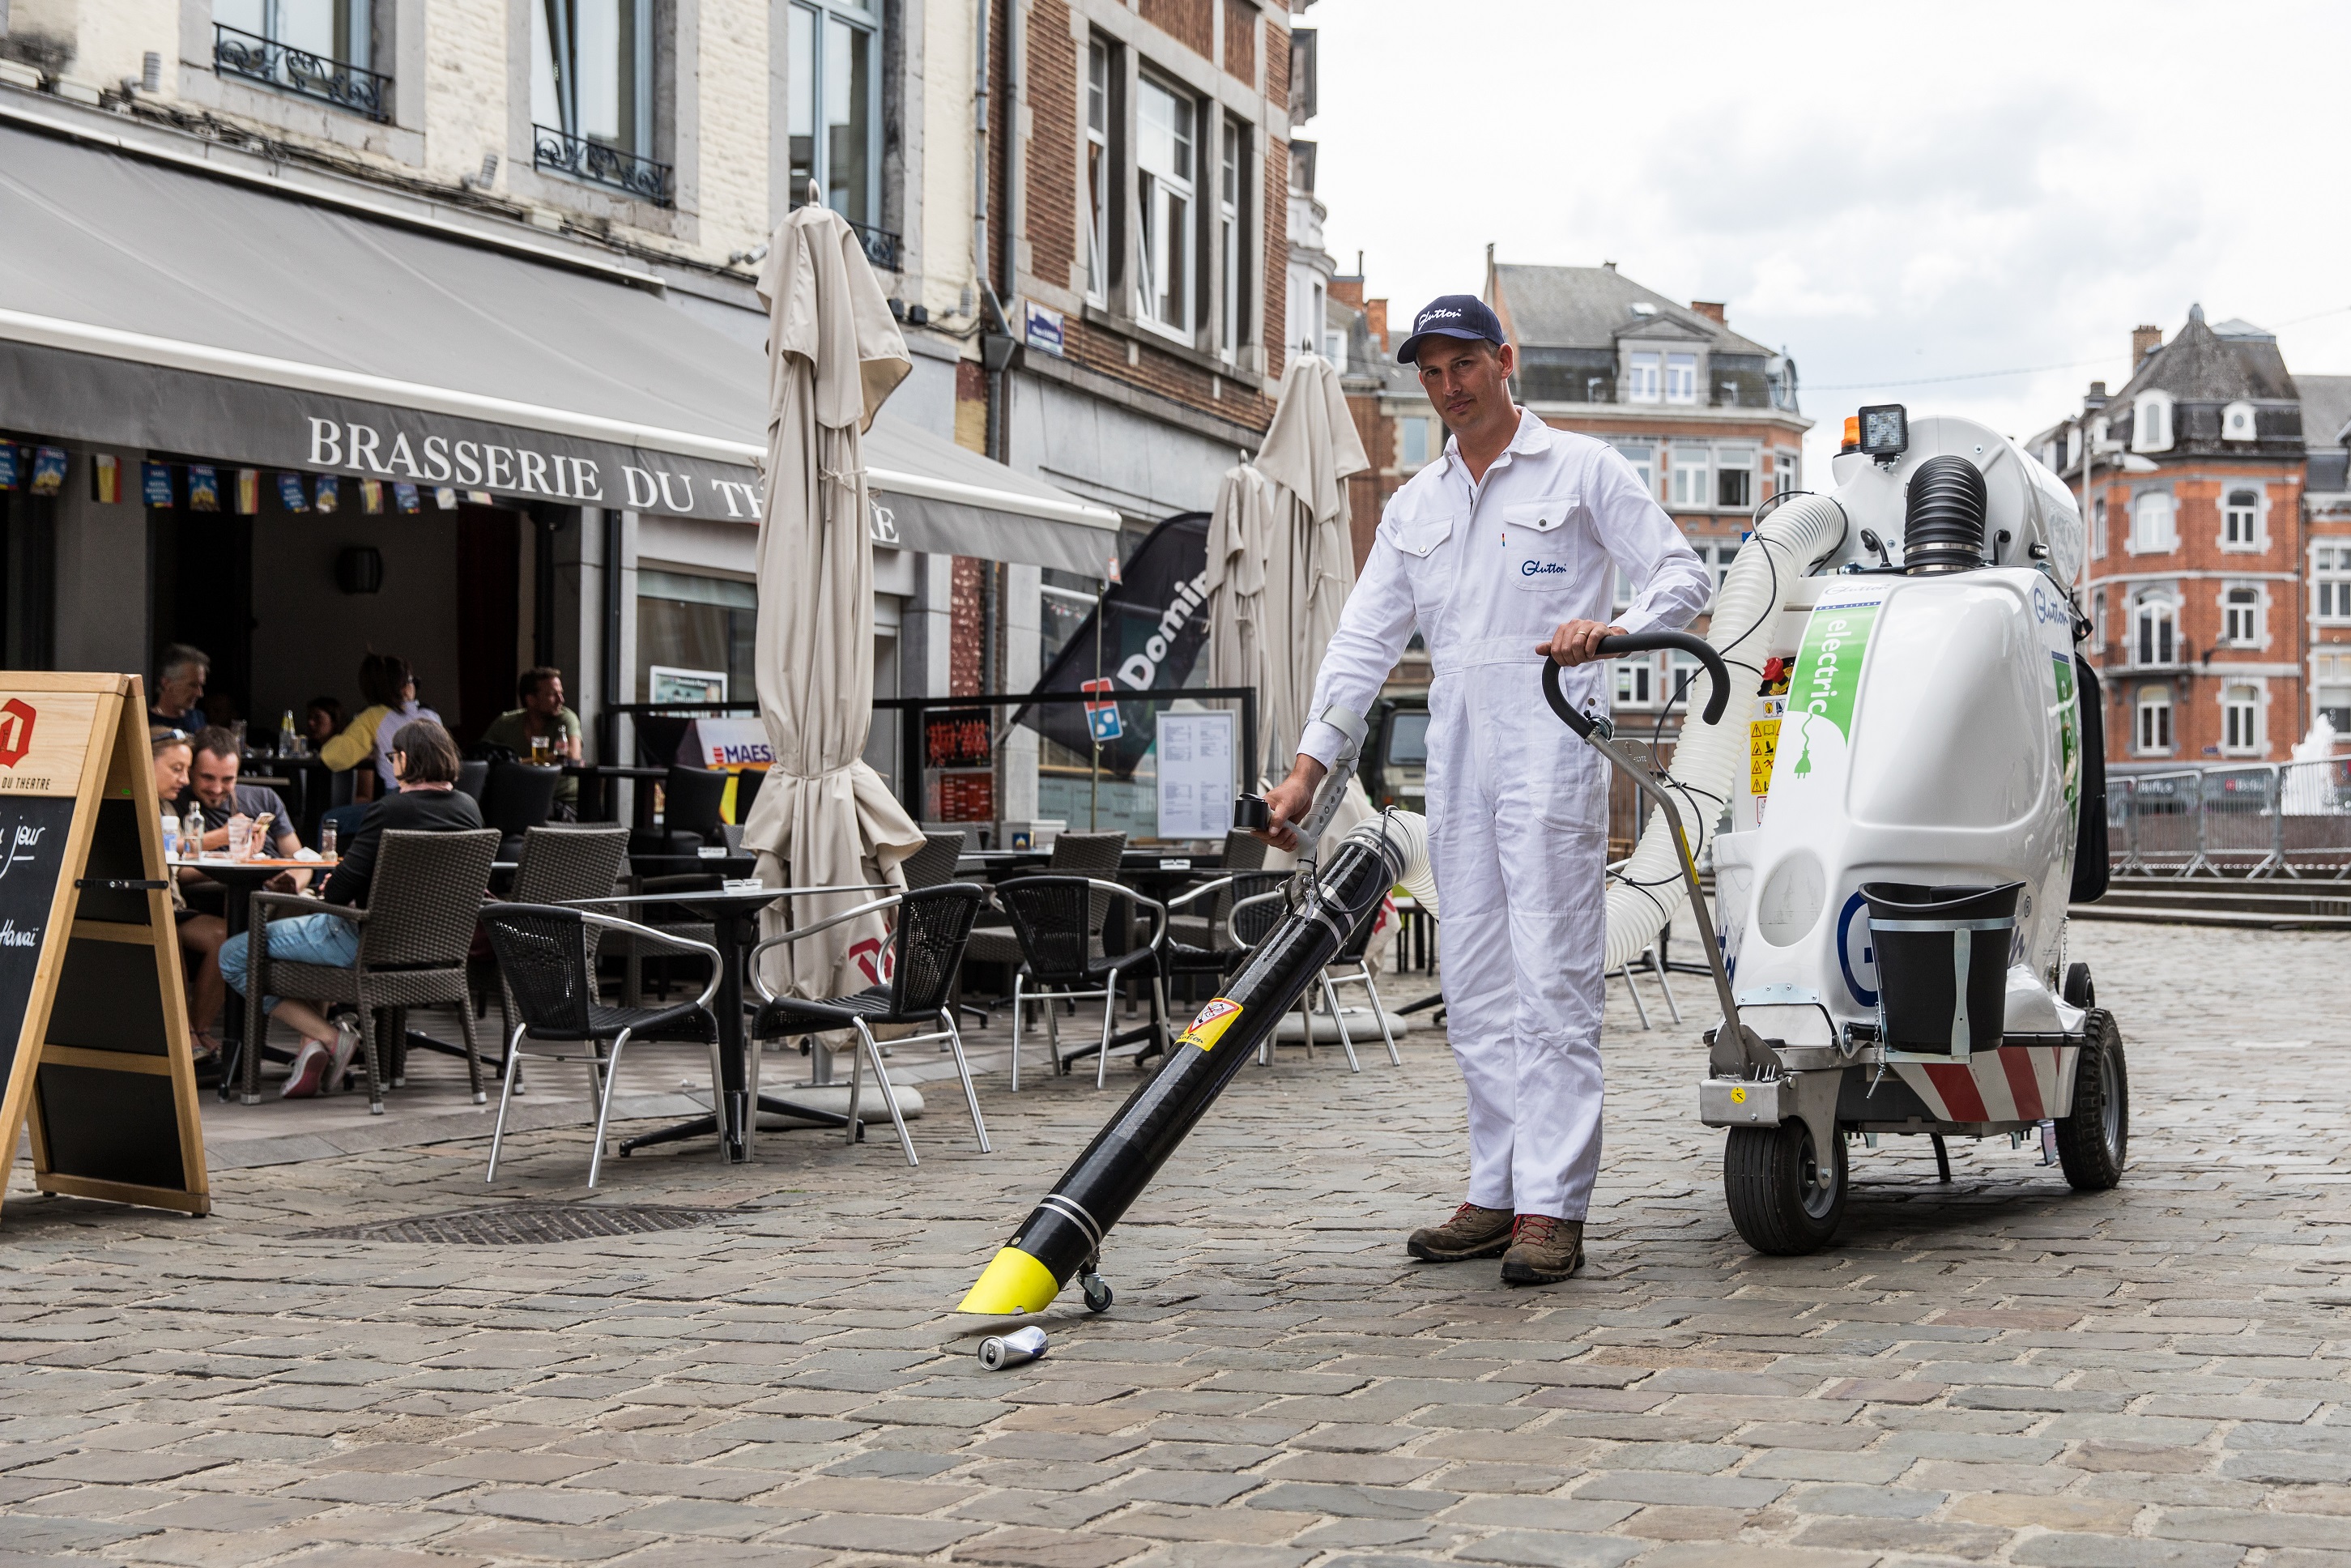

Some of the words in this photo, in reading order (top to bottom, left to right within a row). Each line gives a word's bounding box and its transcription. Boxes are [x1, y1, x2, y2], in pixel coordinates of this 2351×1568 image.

[1417, 308, 1462, 331] Glutton
[306, 415, 603, 502] BRASSERIE
[621, 465, 695, 513] DU
[1521, 560, 1567, 576] Glutton
[1825, 585, 1889, 595] Glutton
[1117, 570, 1207, 691] Domin
[1808, 618, 1852, 714] electric
[725, 744, 771, 763] MAES
[2, 777, 14, 789] DU
[16, 778, 51, 790] THEATRE
